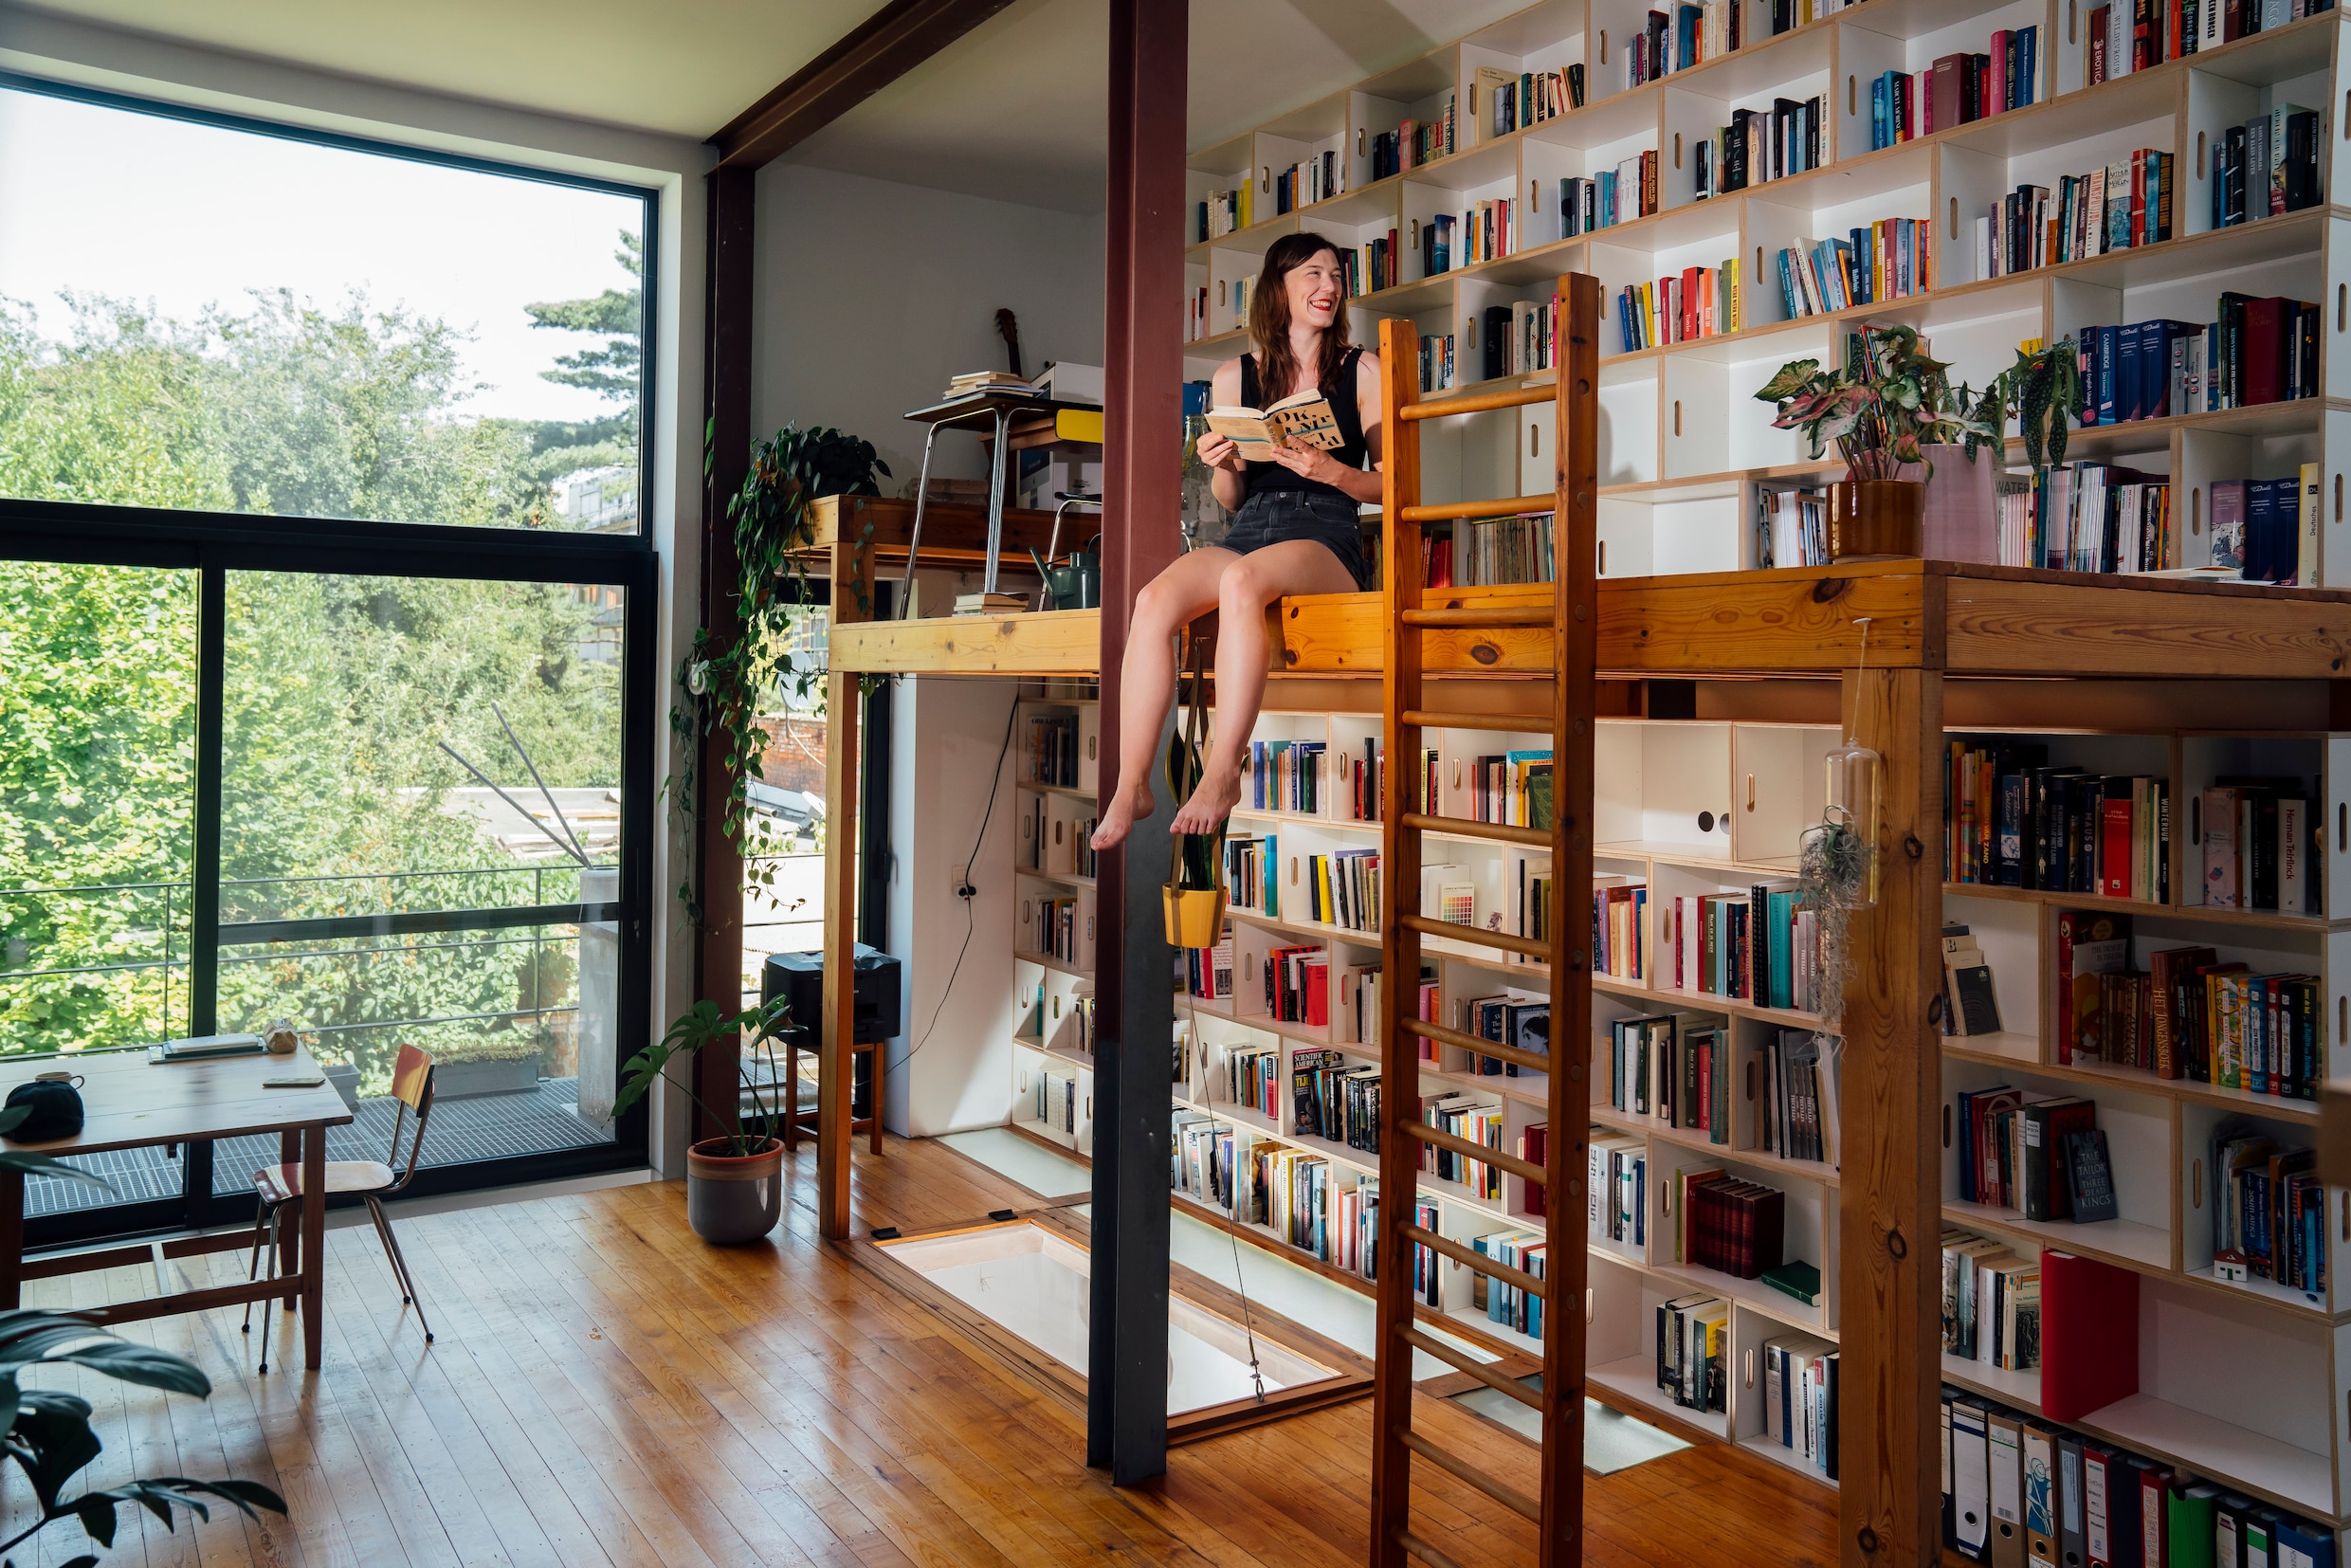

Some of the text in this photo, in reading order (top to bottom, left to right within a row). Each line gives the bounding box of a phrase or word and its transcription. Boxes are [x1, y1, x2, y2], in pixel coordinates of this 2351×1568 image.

[2094, 49, 2103, 85] EROTICA
[2090, 171, 2103, 224] TRAINSPOTTING
[1274, 410, 1317, 425] OK,
[1301, 415, 1331, 432] Mr
[1995, 480, 2029, 494] WATER
[2085, 812, 2093, 842] MAUS
[2286, 810, 2296, 880] Herman Teirlinck
[2103, 944, 2123, 953] DESERT
[2154, 988, 2170, 1069] HET JONGENSBOEK
[1295, 1052, 1323, 1062] SCIENTIFIC
[1295, 1059, 1323, 1067] AMERICAN
[2081, 1151, 2099, 1162] TALE
[2078, 1163, 2105, 1176] TAILOR
[2082, 1177, 2105, 1189] THREE
[2085, 1188, 2105, 1196] DEAD
[2081, 1194, 2110, 1209] KINGS
